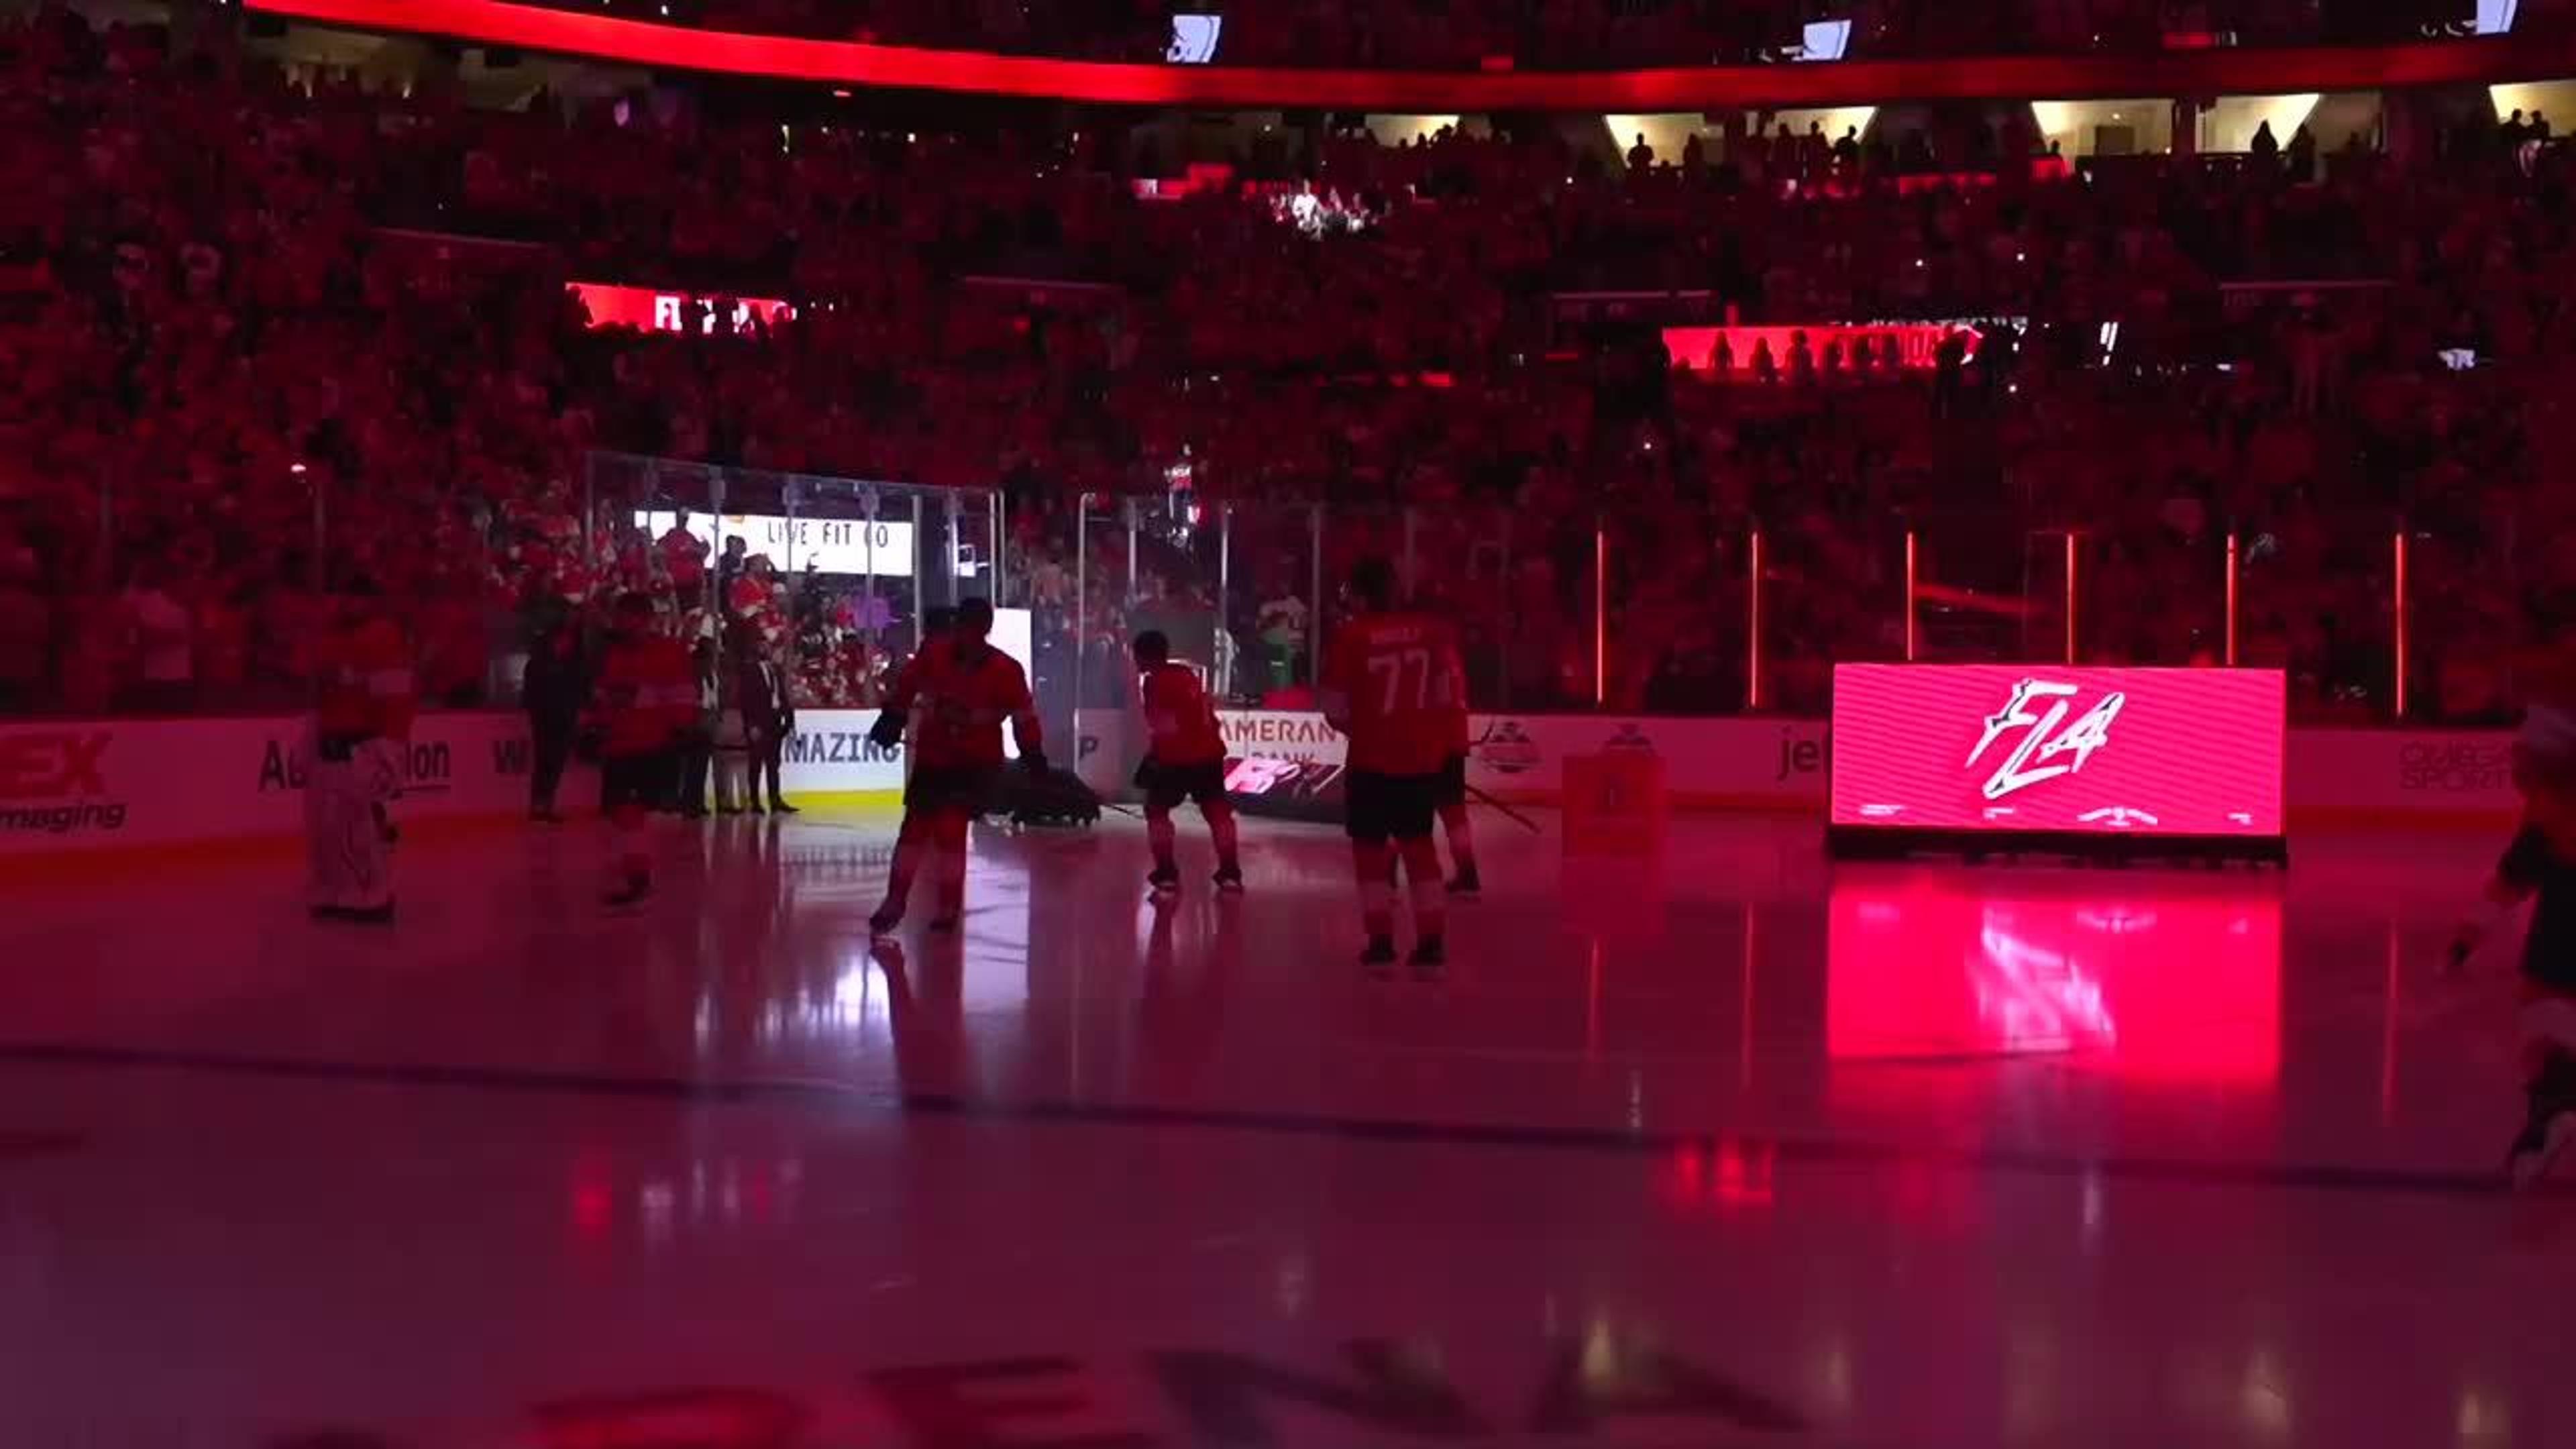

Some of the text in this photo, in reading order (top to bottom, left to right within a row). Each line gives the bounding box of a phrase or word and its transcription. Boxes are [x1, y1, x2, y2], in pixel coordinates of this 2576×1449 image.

[768, 521, 808, 545] LIVE
[822, 523, 850, 545] FIT
[1367, 647, 1430, 714] 77
[1966, 678, 2125, 799] FLA
